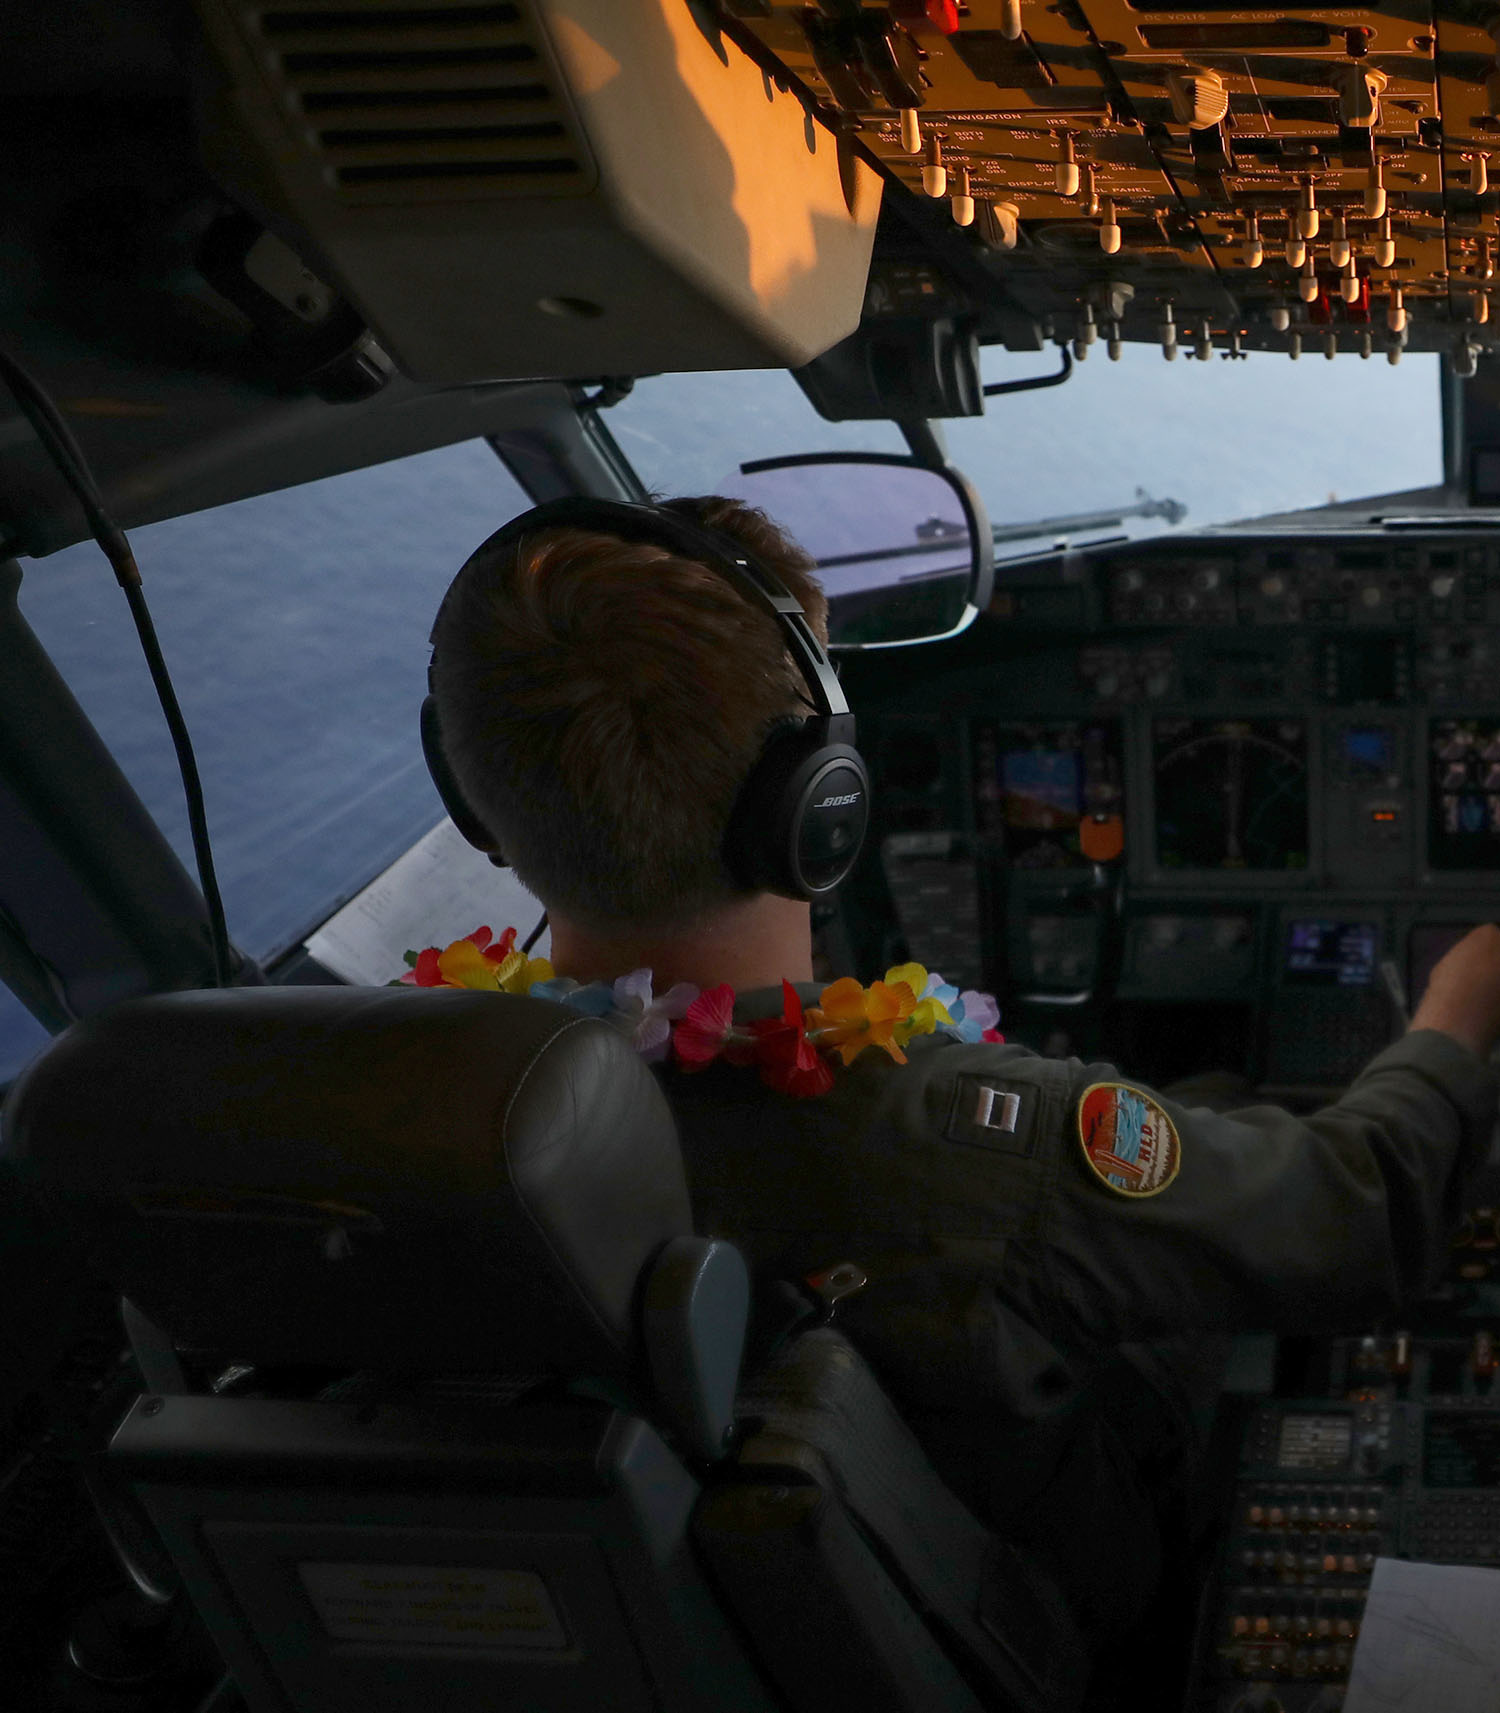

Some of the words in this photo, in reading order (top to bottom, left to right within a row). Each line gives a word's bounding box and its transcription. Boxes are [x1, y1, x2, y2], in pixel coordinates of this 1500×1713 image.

[946, 113, 1022, 121] NAVIGATION
[814, 792, 861, 808] BOSE
[1138, 1124, 1153, 1162] HLD
[1397, 1337, 1407, 1364] 1
